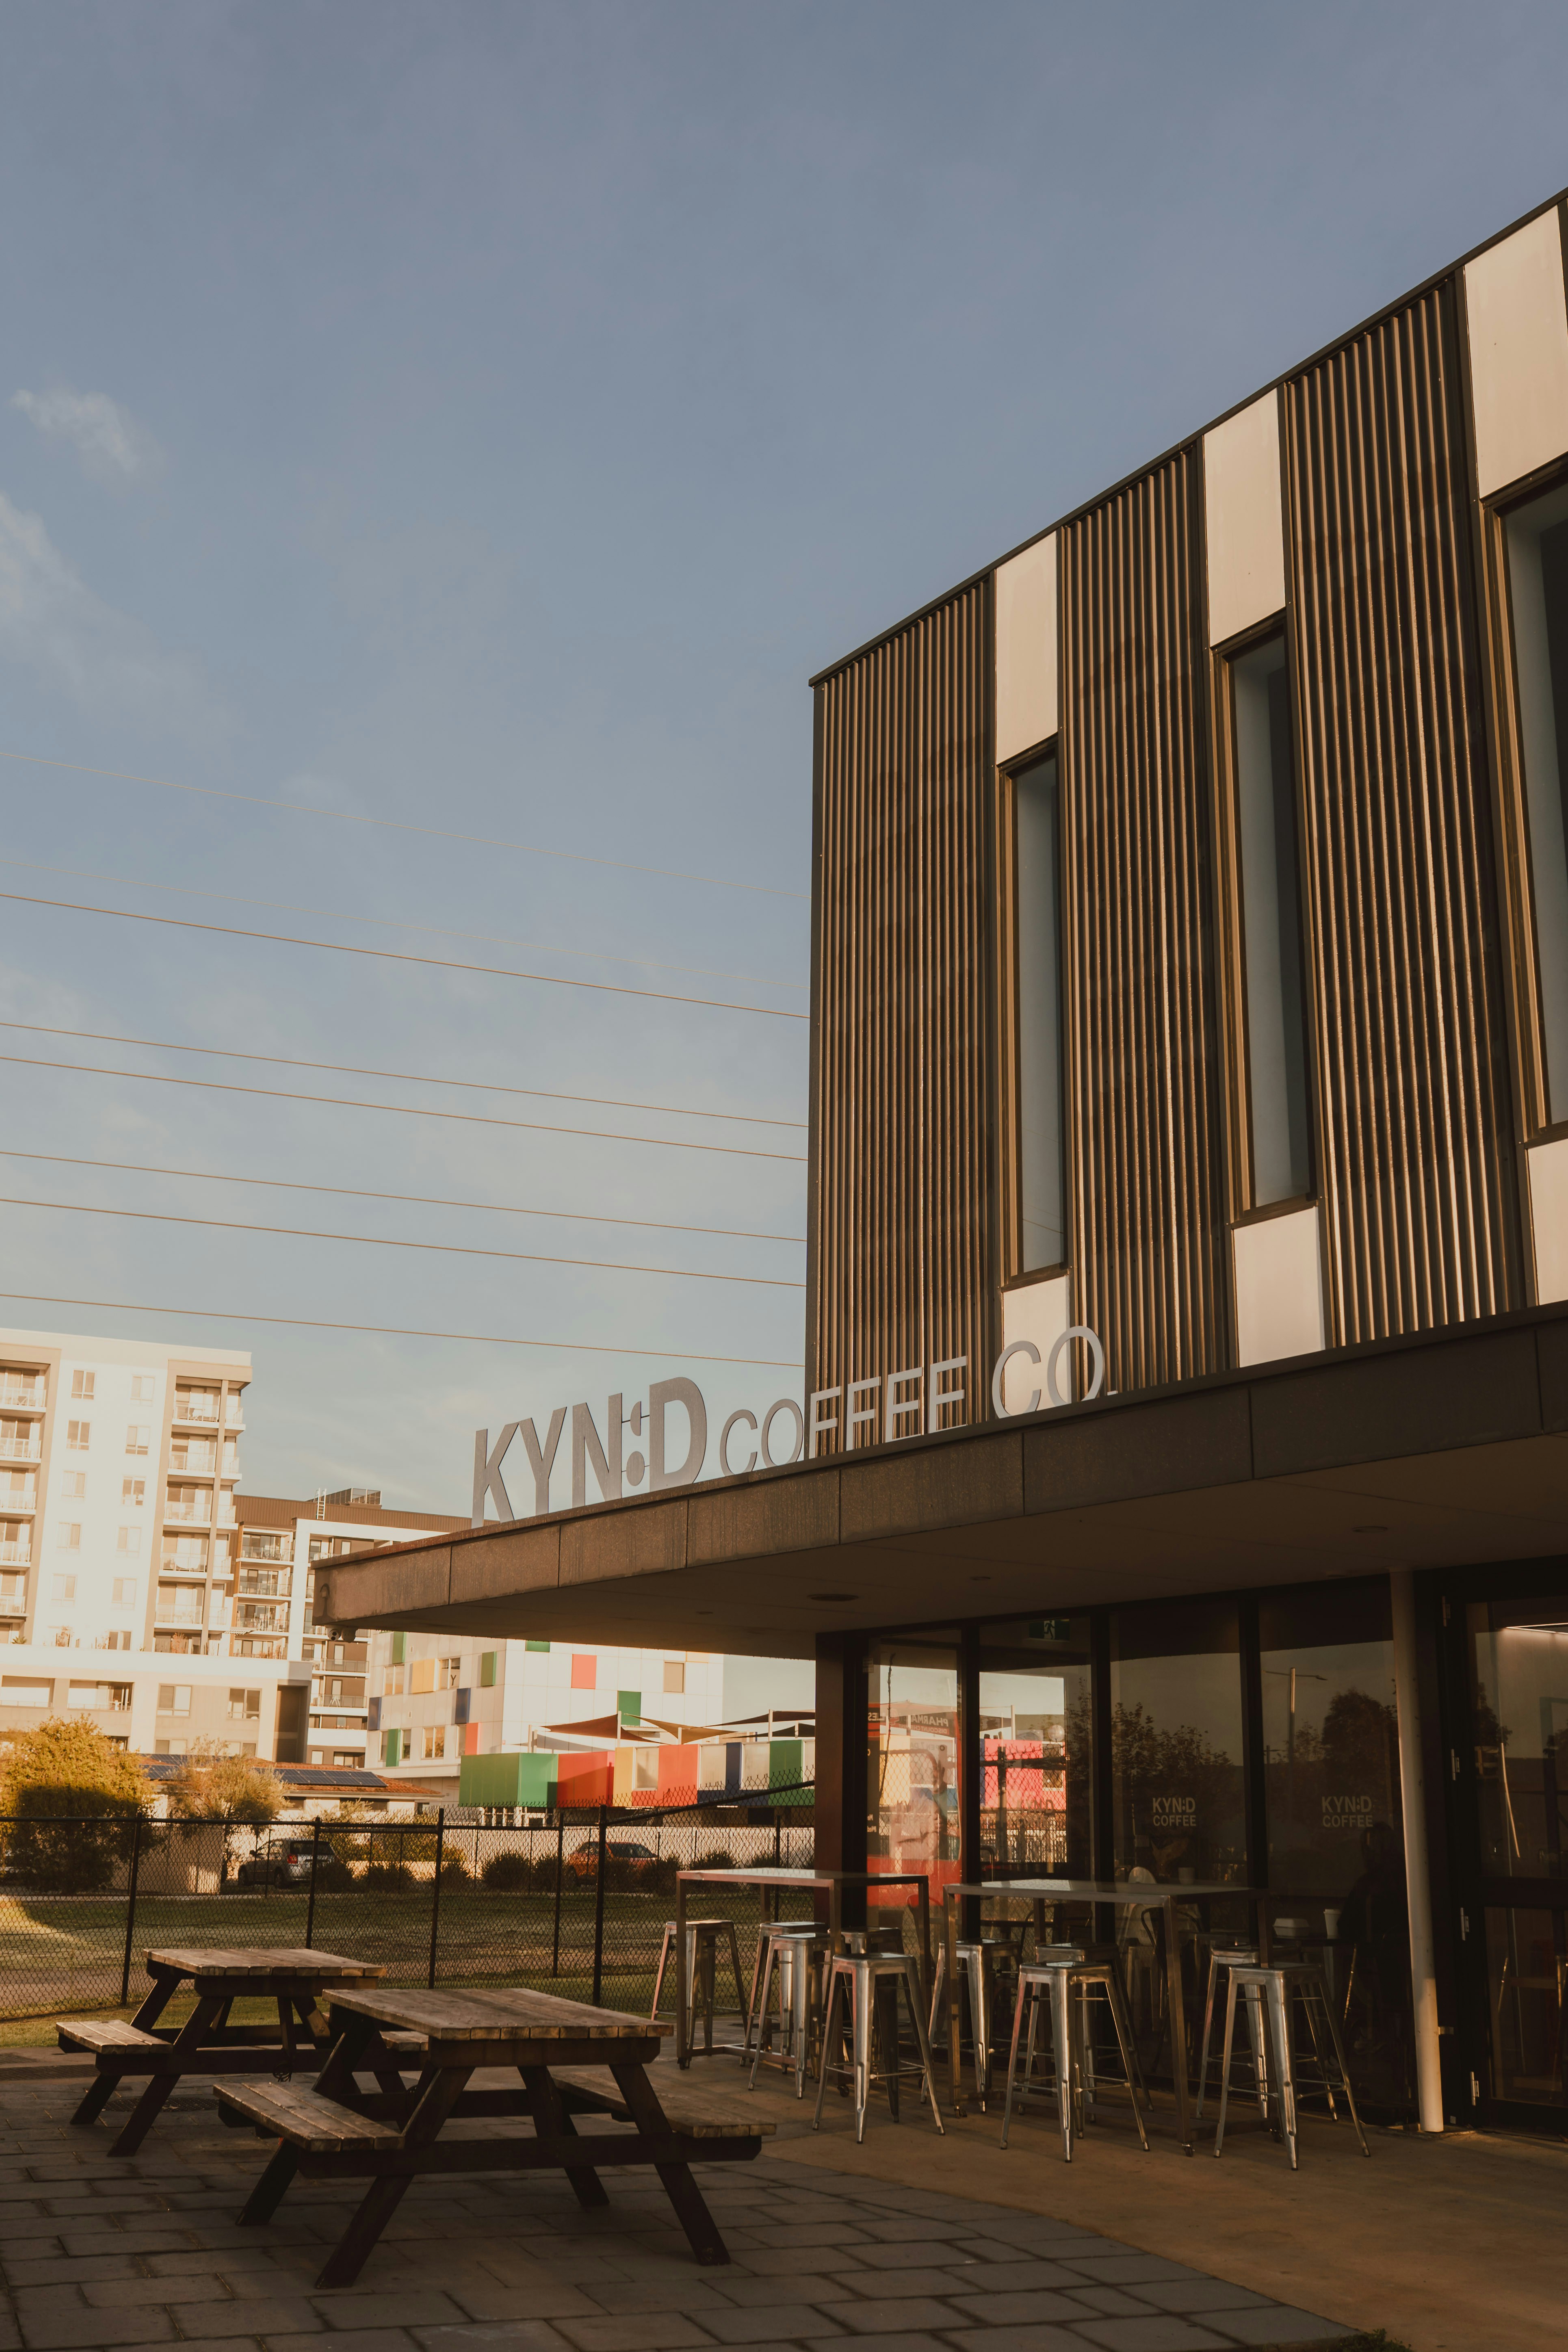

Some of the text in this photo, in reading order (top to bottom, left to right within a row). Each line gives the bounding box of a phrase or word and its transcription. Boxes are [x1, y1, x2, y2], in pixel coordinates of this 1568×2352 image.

[720, 1356, 968, 1475] COFFEE
[1153, 1815, 1196, 1827] COFFEE
[1322, 1815, 1373, 1828] COFFEE
